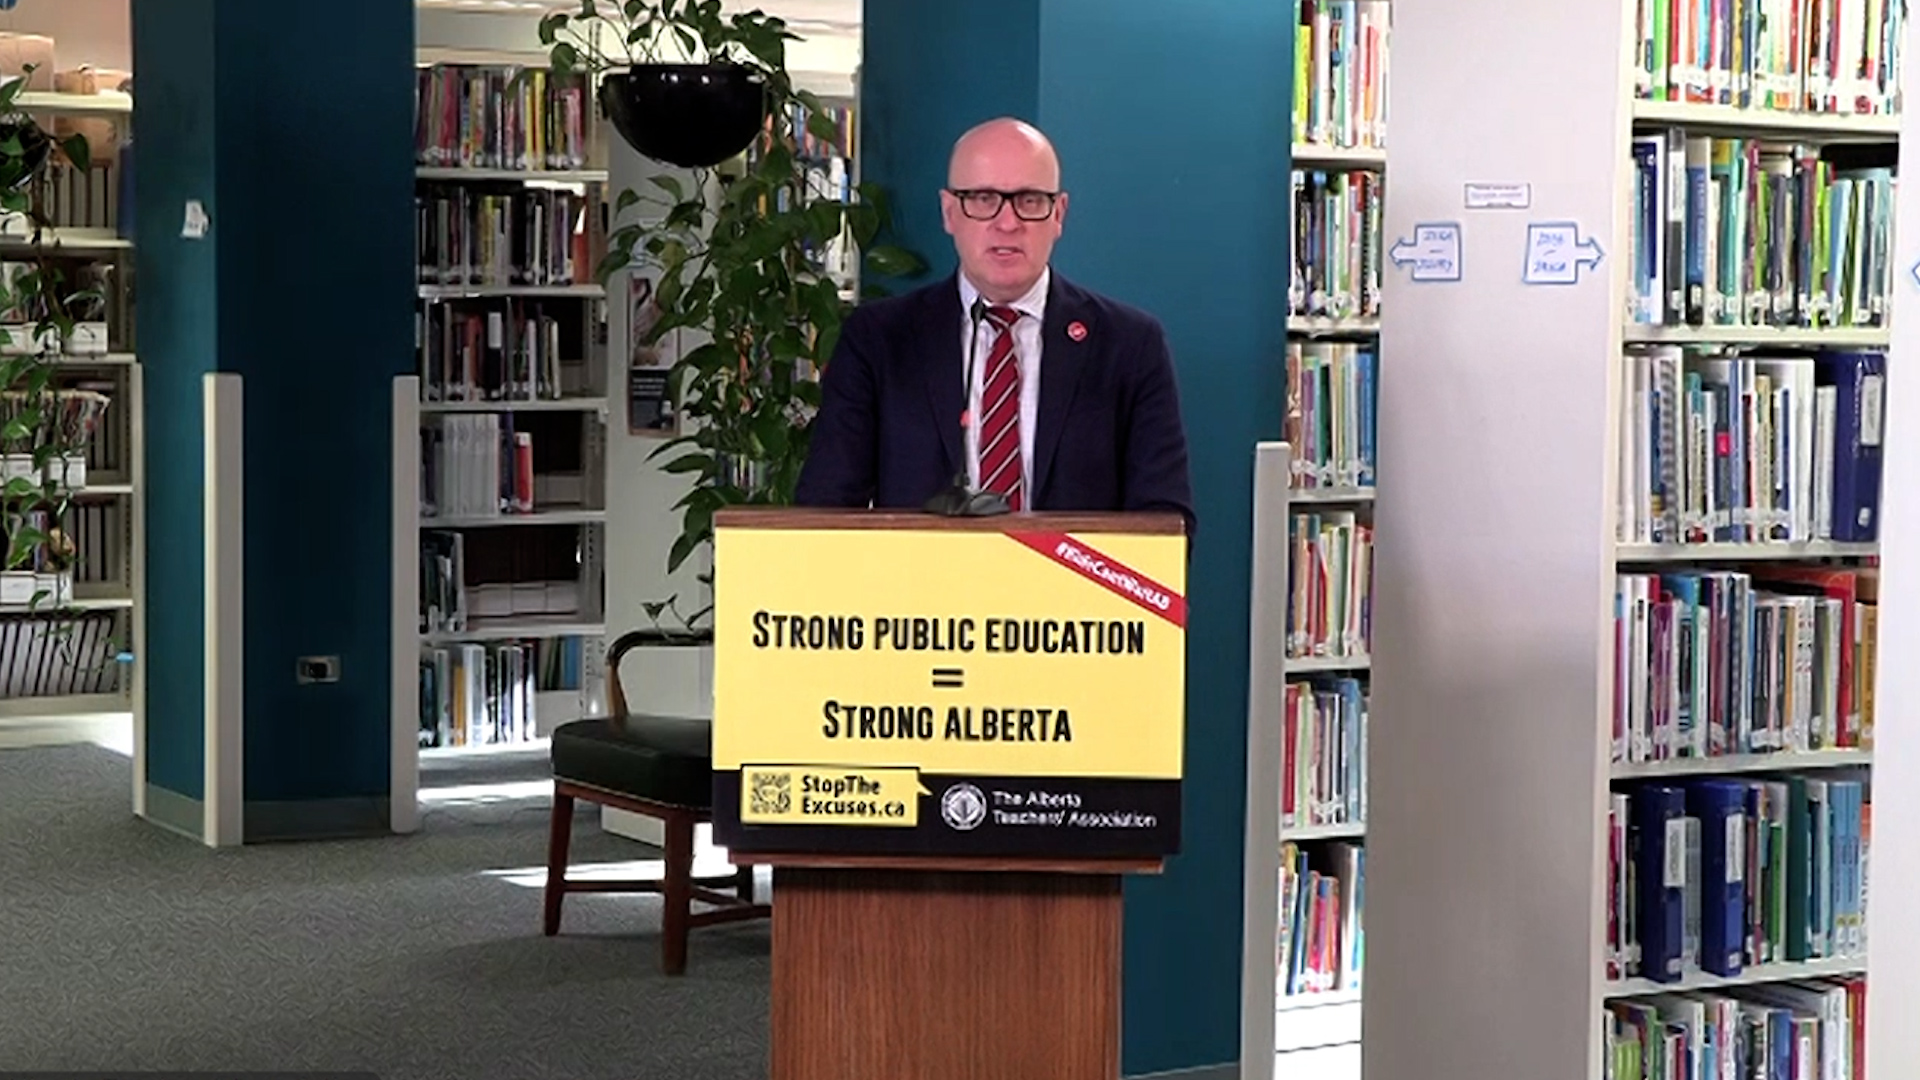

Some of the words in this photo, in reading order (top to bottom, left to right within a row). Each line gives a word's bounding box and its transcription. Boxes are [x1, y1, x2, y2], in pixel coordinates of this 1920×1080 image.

[875, 618, 975, 651] PUBLIC
[986, 620, 1144, 654] EDUCATION
[945, 706, 1072, 741] ALBERTA
[802, 775, 881, 797] StopThe
[802, 797, 906, 817] Excuses.ca
[992, 791, 1022, 805] The
[1067, 811, 1157, 828] Association
